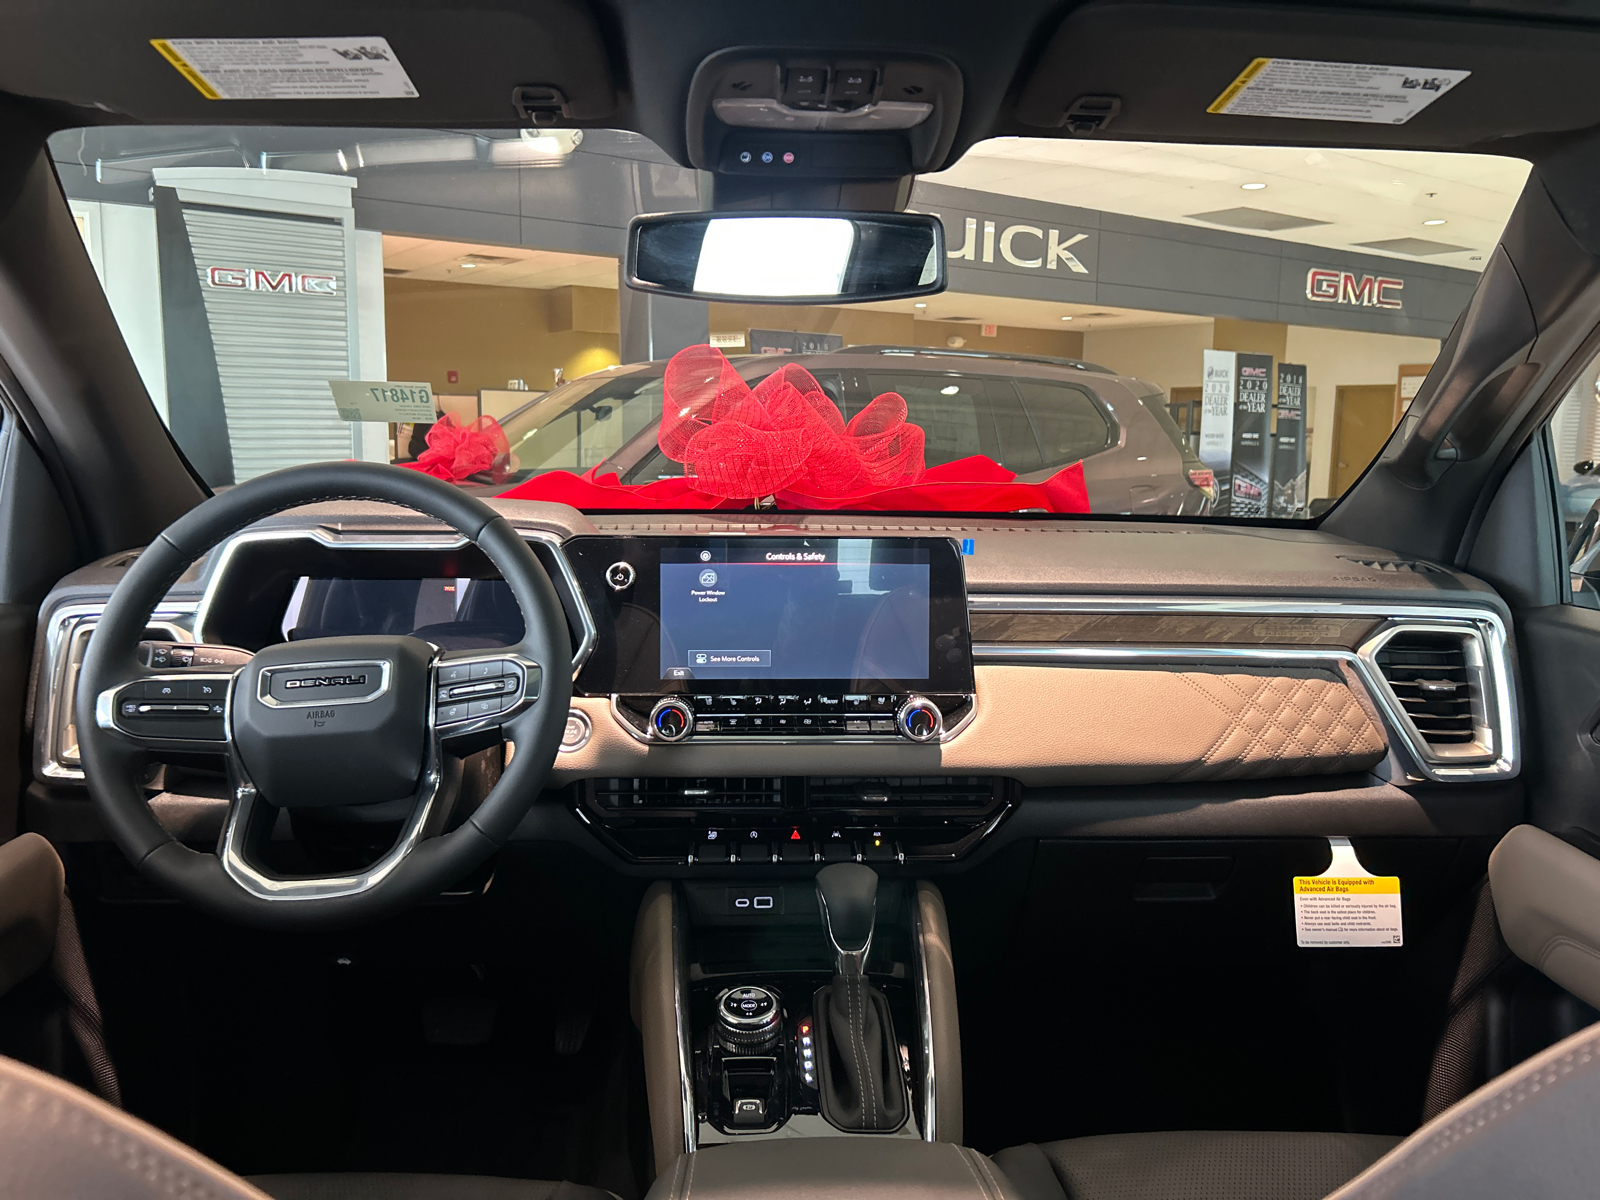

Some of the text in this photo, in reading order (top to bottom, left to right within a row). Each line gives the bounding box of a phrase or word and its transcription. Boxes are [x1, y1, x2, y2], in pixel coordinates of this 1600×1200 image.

[904, 209, 1089, 274] UICK
[206, 266, 336, 296] GMC
[1306, 267, 1404, 309] GMC
[1242, 367, 1266, 377] GMC
[1239, 380, 1268, 390] 2020
[1279, 386, 1302, 397] DEALER
[1205, 396, 1228, 406] DEALER
[1239, 392, 1266, 403] DEALER
[1286, 396, 1301, 406] YEAR
[1211, 406, 1228, 416] YEAR
[1247, 402, 1266, 413] YEAR
[766, 552, 826, 562] Controls & Safety
[285, 674, 367, 689] DENALI
[306, 709, 336, 719] AIRBAG
[1338, 879, 1362, 887] Equipped
